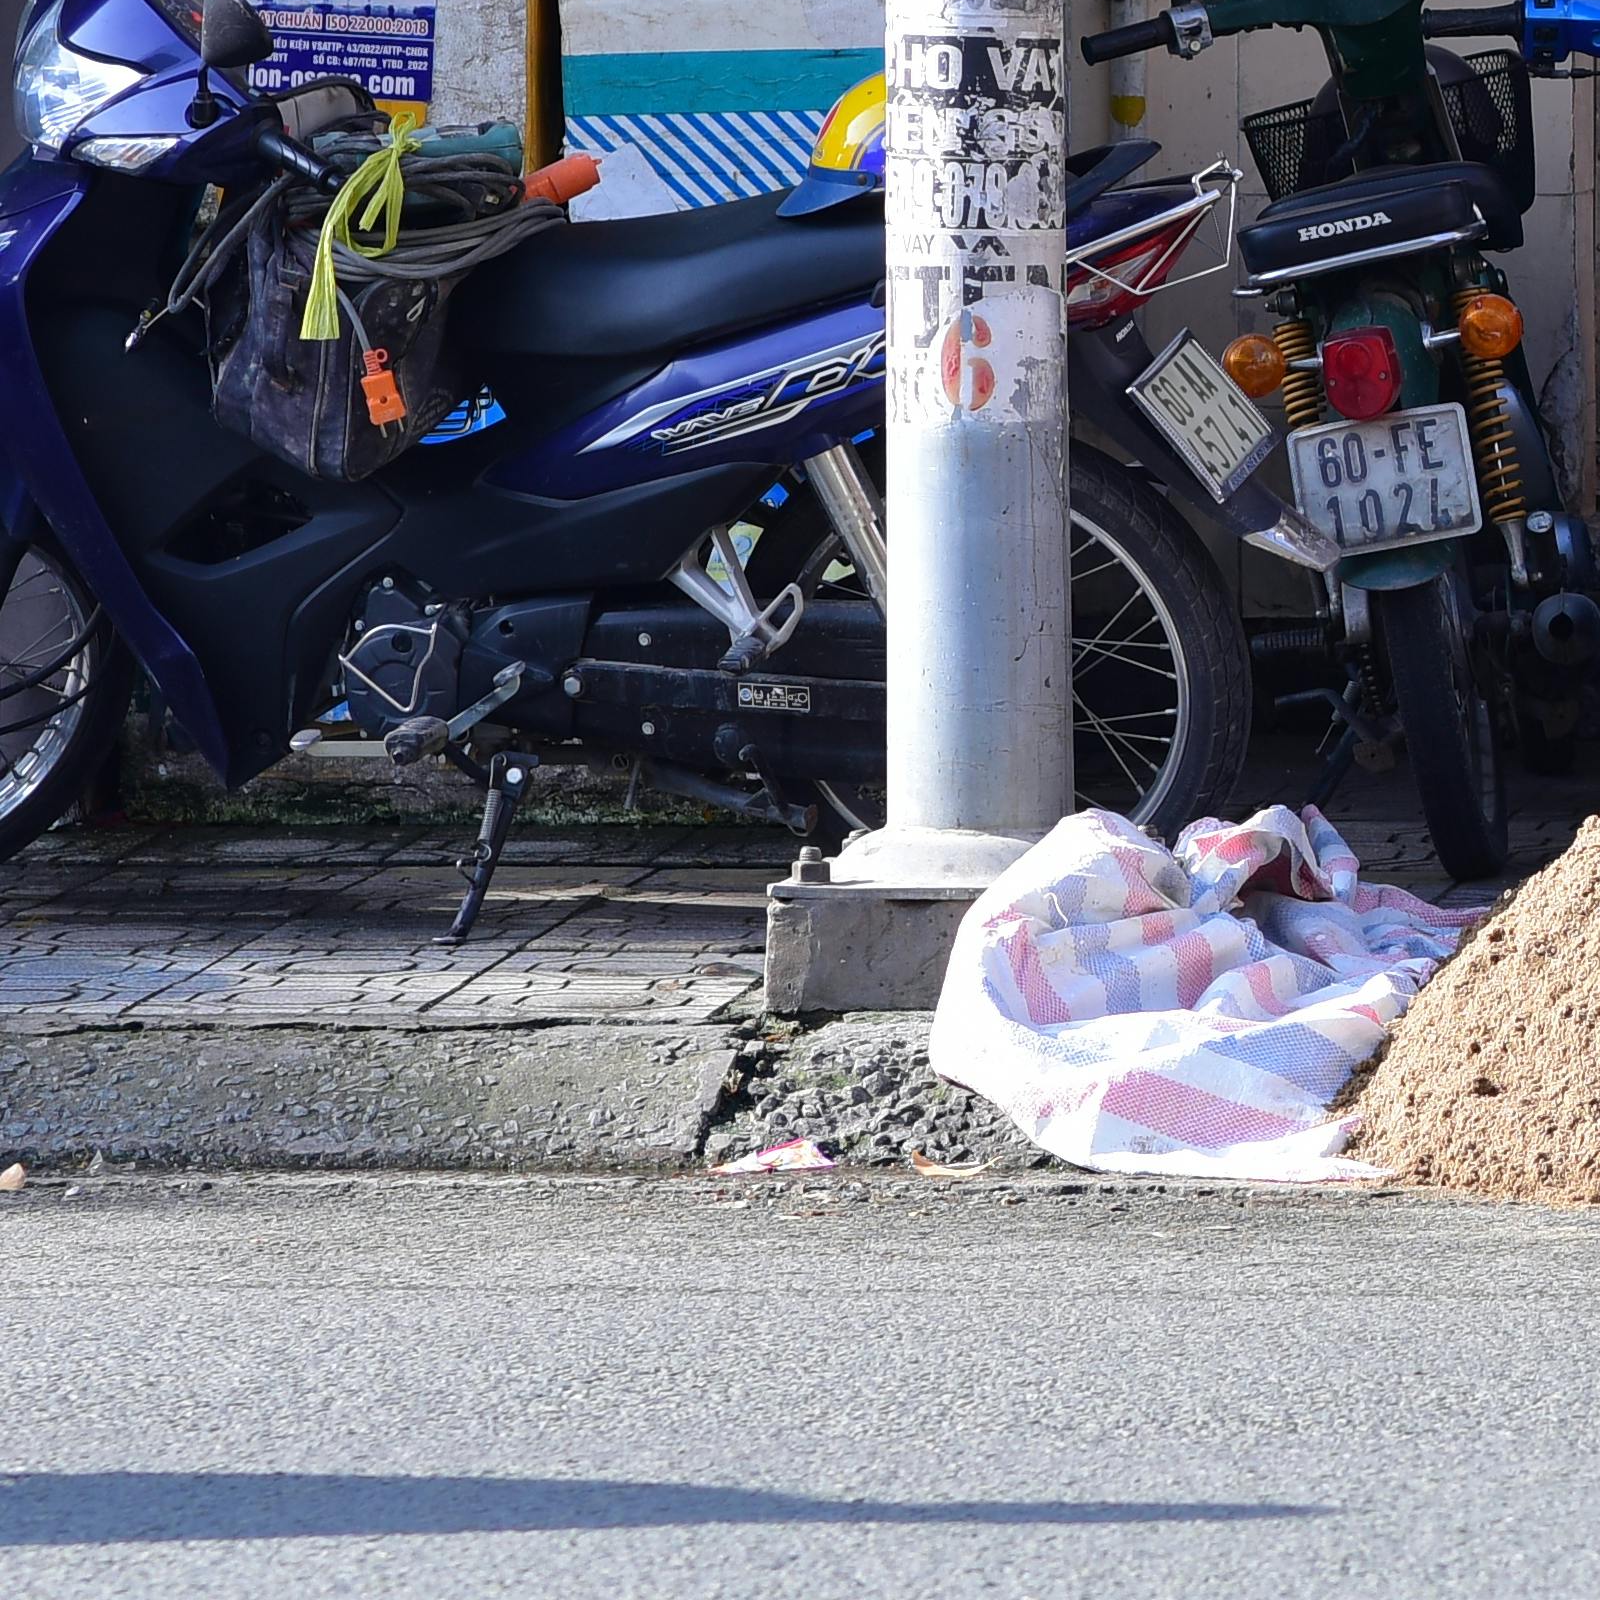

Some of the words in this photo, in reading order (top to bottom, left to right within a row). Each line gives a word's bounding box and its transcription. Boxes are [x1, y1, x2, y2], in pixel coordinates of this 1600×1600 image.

[326, 14, 349, 29] ISO
[351, 17, 428, 34] 22000:2018
[1297, 211, 1392, 242] HONDA
[651, 396, 764, 440] WAVE
[1317, 418, 1443, 488] 60-FE
